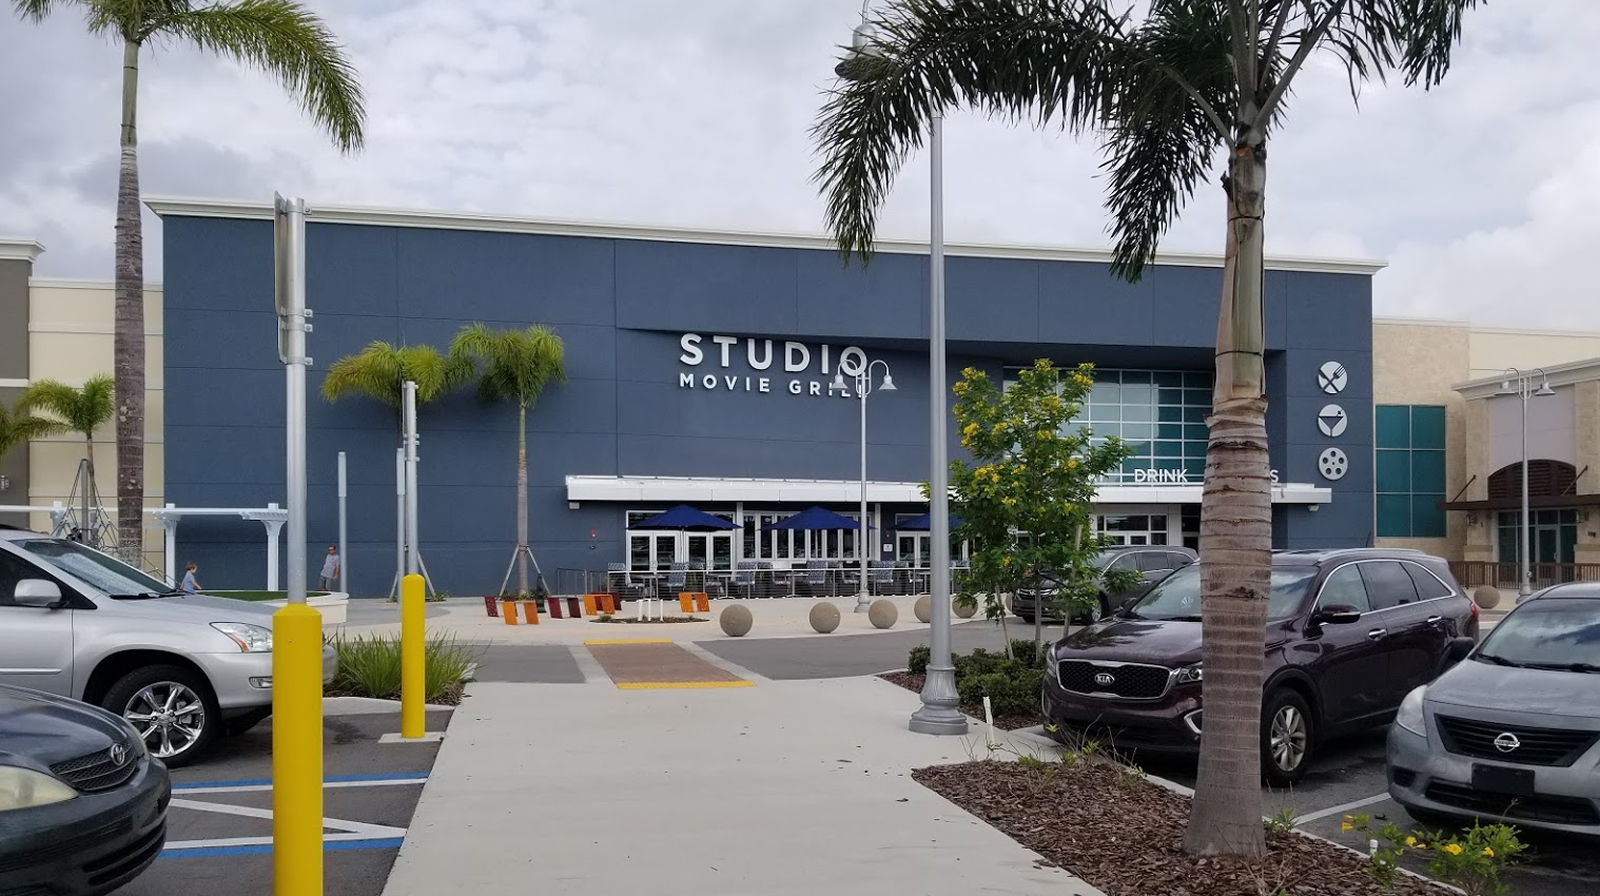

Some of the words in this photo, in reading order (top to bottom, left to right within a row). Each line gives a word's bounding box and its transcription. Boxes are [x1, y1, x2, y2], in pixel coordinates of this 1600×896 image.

[680, 333, 867, 376] STUDIO
[680, 373, 770, 393] MOVIE
[1134, 469, 1188, 483] DRINK
